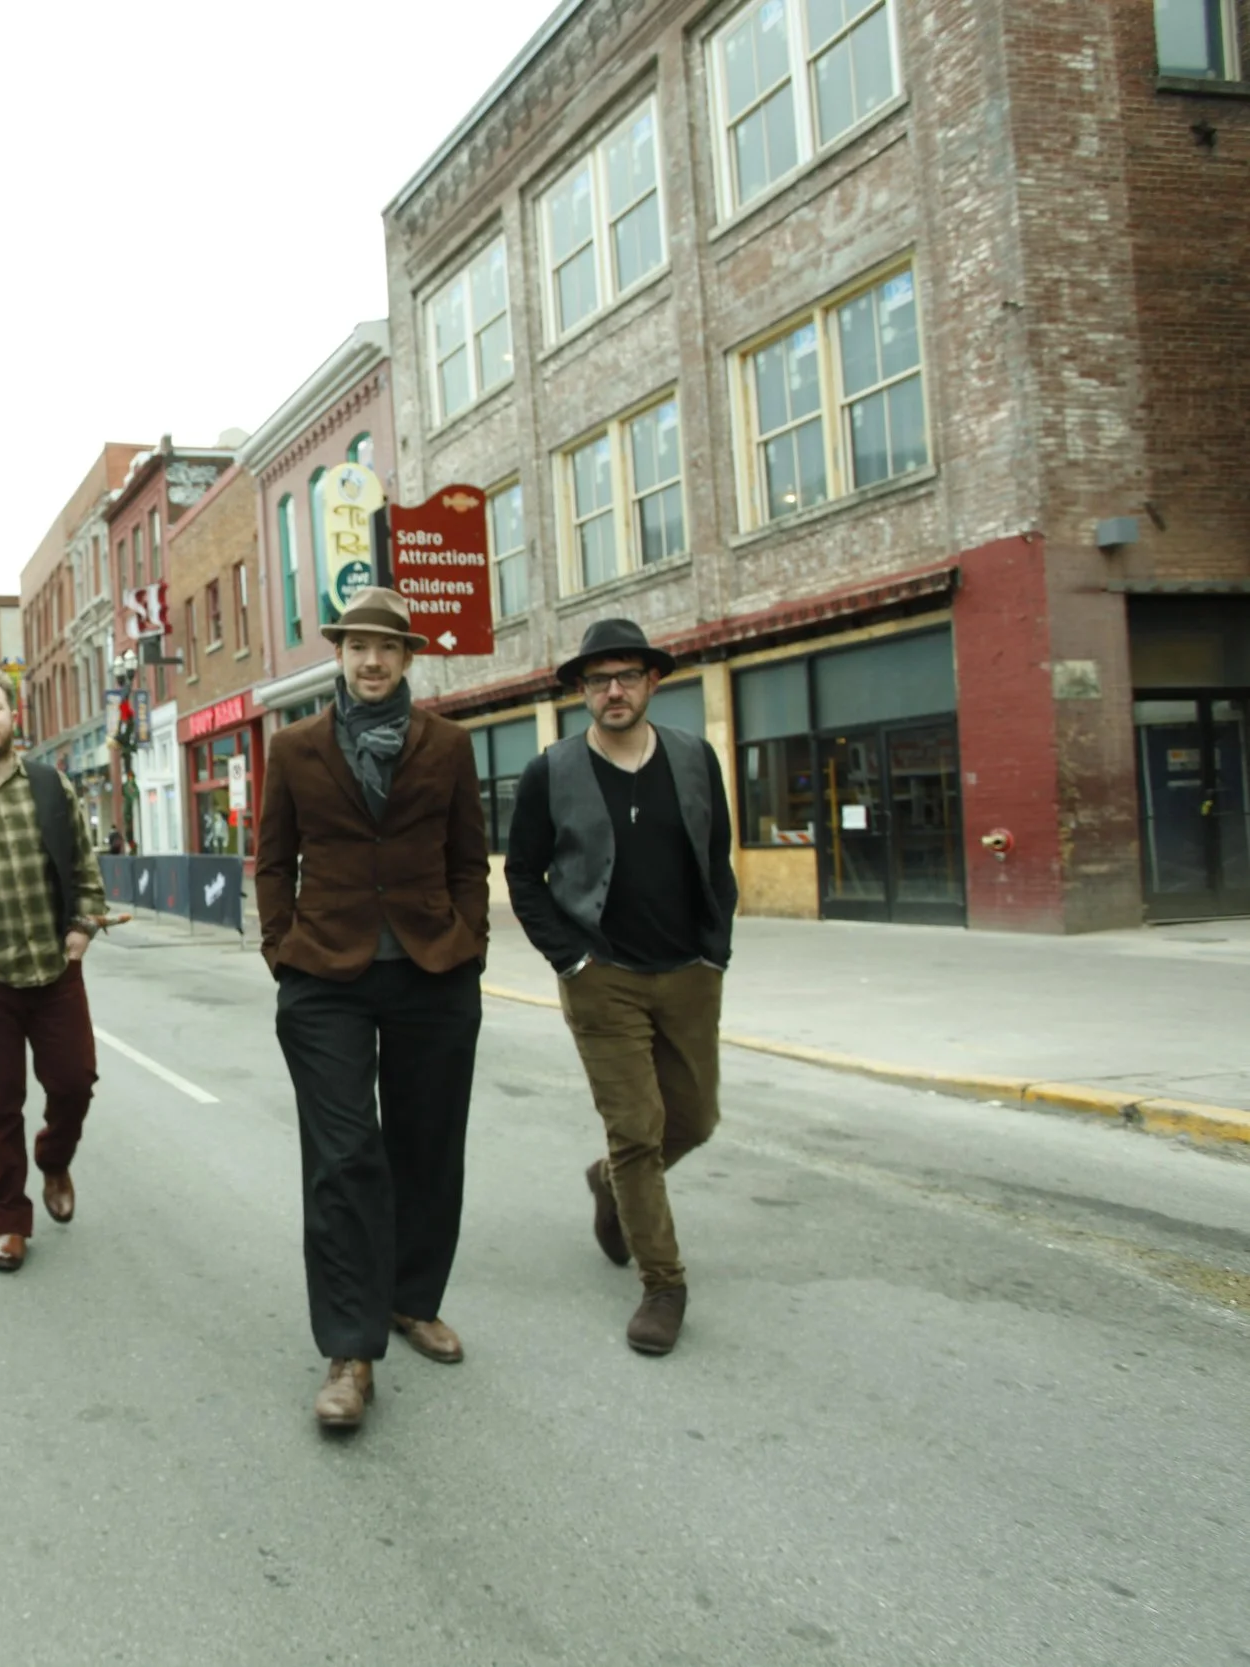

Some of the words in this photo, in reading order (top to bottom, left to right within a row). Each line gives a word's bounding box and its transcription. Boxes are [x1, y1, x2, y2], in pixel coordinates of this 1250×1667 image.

[396, 529, 443, 546] SoBro
[398, 549, 486, 567] Attractions
[399, 577, 474, 596] Childrens
[407, 597, 462, 615] heatre
